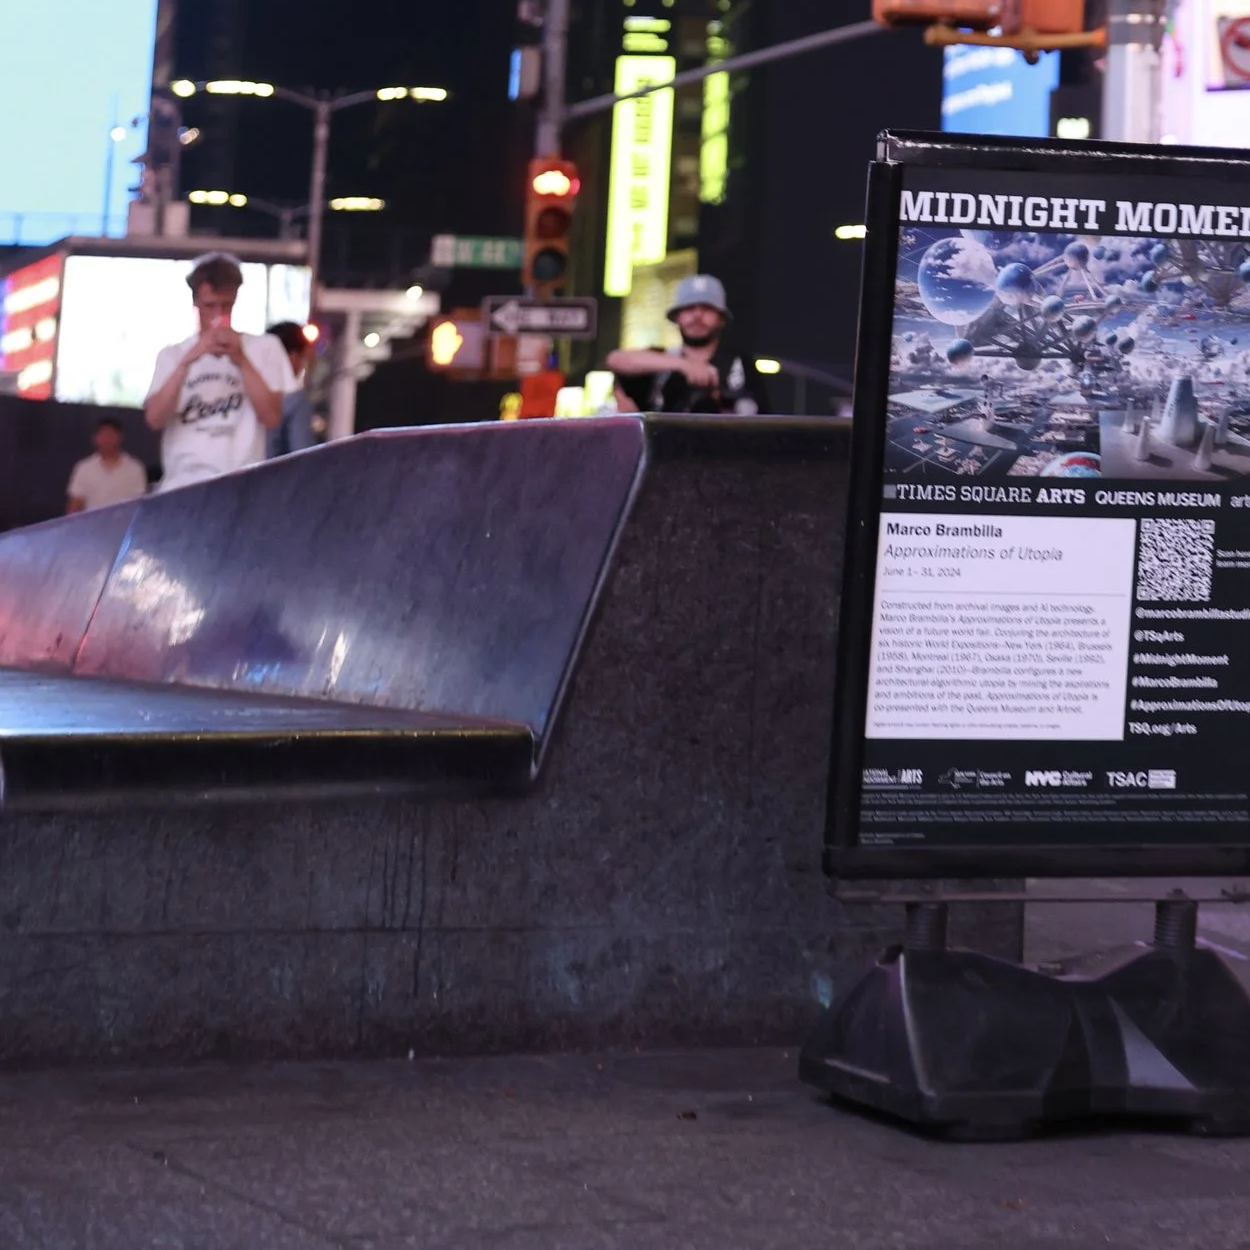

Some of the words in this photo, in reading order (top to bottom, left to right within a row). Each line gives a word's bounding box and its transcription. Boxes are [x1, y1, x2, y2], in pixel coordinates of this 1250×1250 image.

[899, 190, 1106, 230] MIDNIGHT
[897, 484, 956, 501] TIMES
[960, 486, 1032, 503] SQUARE
[1036, 488, 1086, 504] ARTS
[1095, 490, 1156, 506] QUEENS
[1157, 492, 1222, 508] MUSEUM
[886, 523, 931, 537] Marco
[935, 524, 1003, 538] Brambilla
[884, 544, 995, 561] Approximations
[999, 546, 1015, 561] of
[1017, 547, 1063, 562] Utopia
[1106, 771, 1148, 787] TSAC
